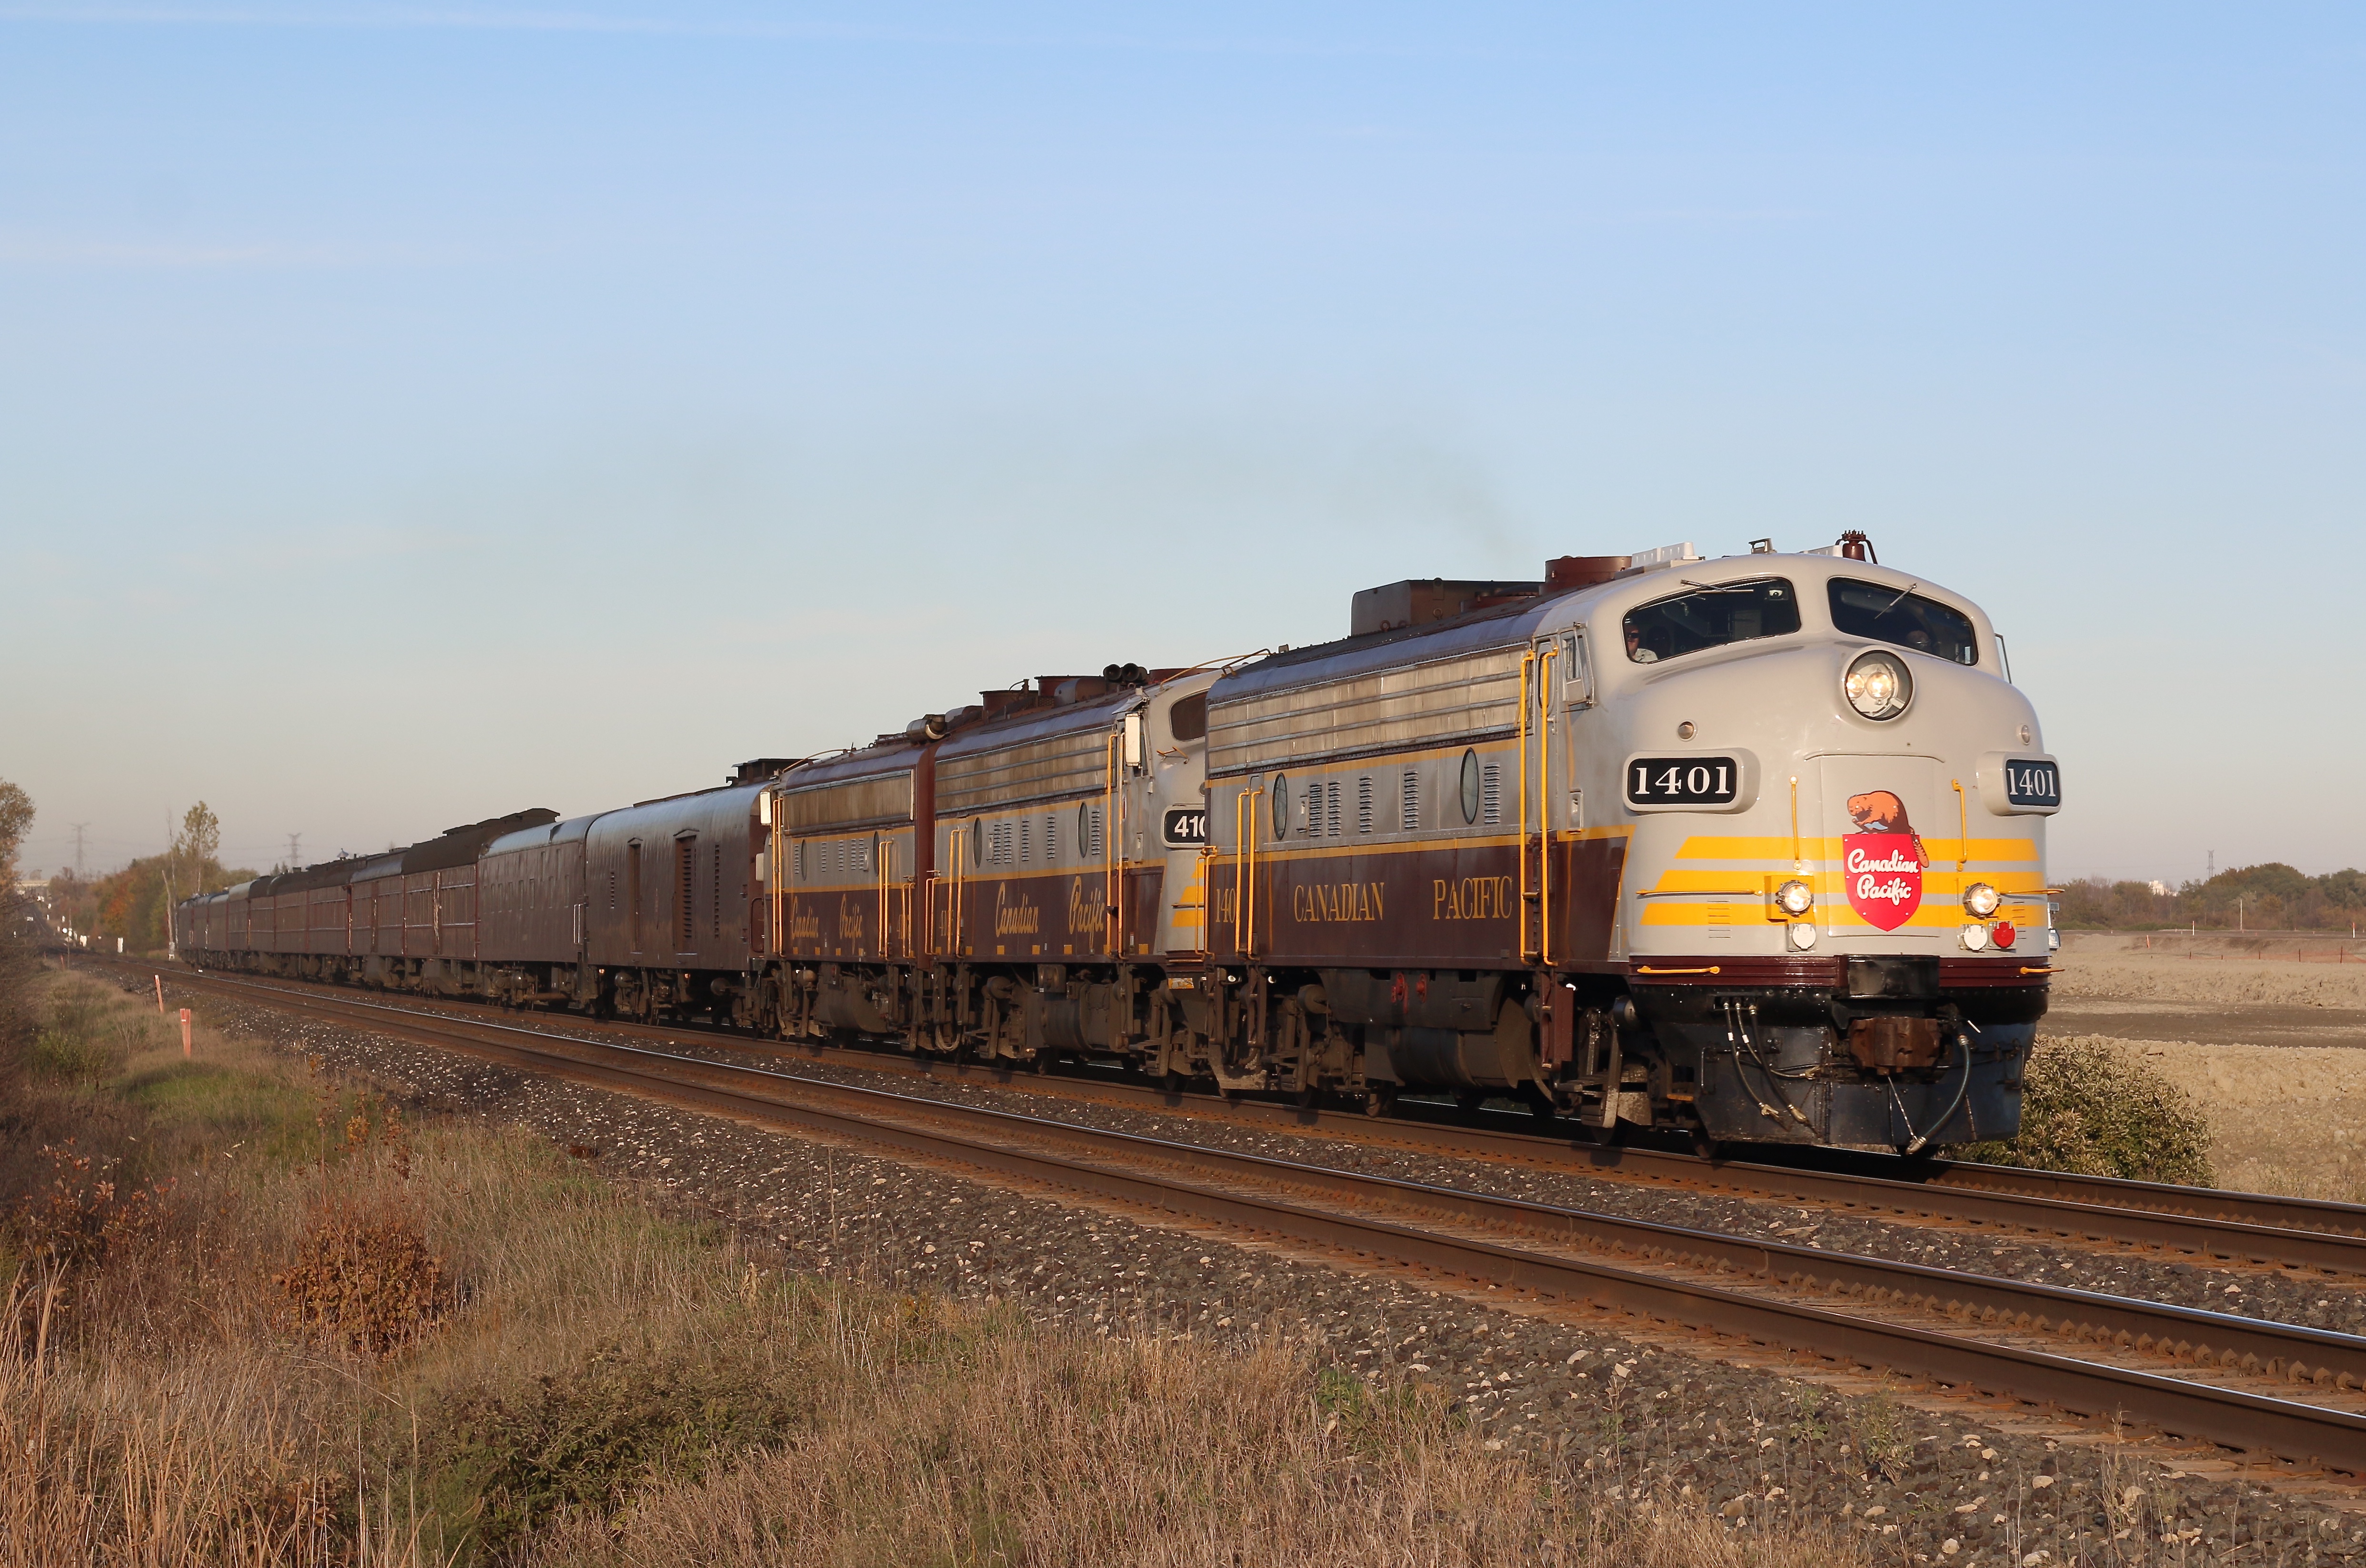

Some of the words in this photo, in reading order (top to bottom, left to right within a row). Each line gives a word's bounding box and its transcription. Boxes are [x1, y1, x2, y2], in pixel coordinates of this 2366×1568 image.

[1635, 767, 1730, 794] 1401
[2007, 768, 2056, 797] 1401
[1847, 848, 1919, 873] Canadian
[1294, 882, 1385, 922] CANADIAN
[1433, 876, 1513, 920] PACIFIC
[1856, 874, 1912, 906] Pacific
[996, 881, 1038, 938] Canadian
[1069, 876, 1105, 949] Pacific
